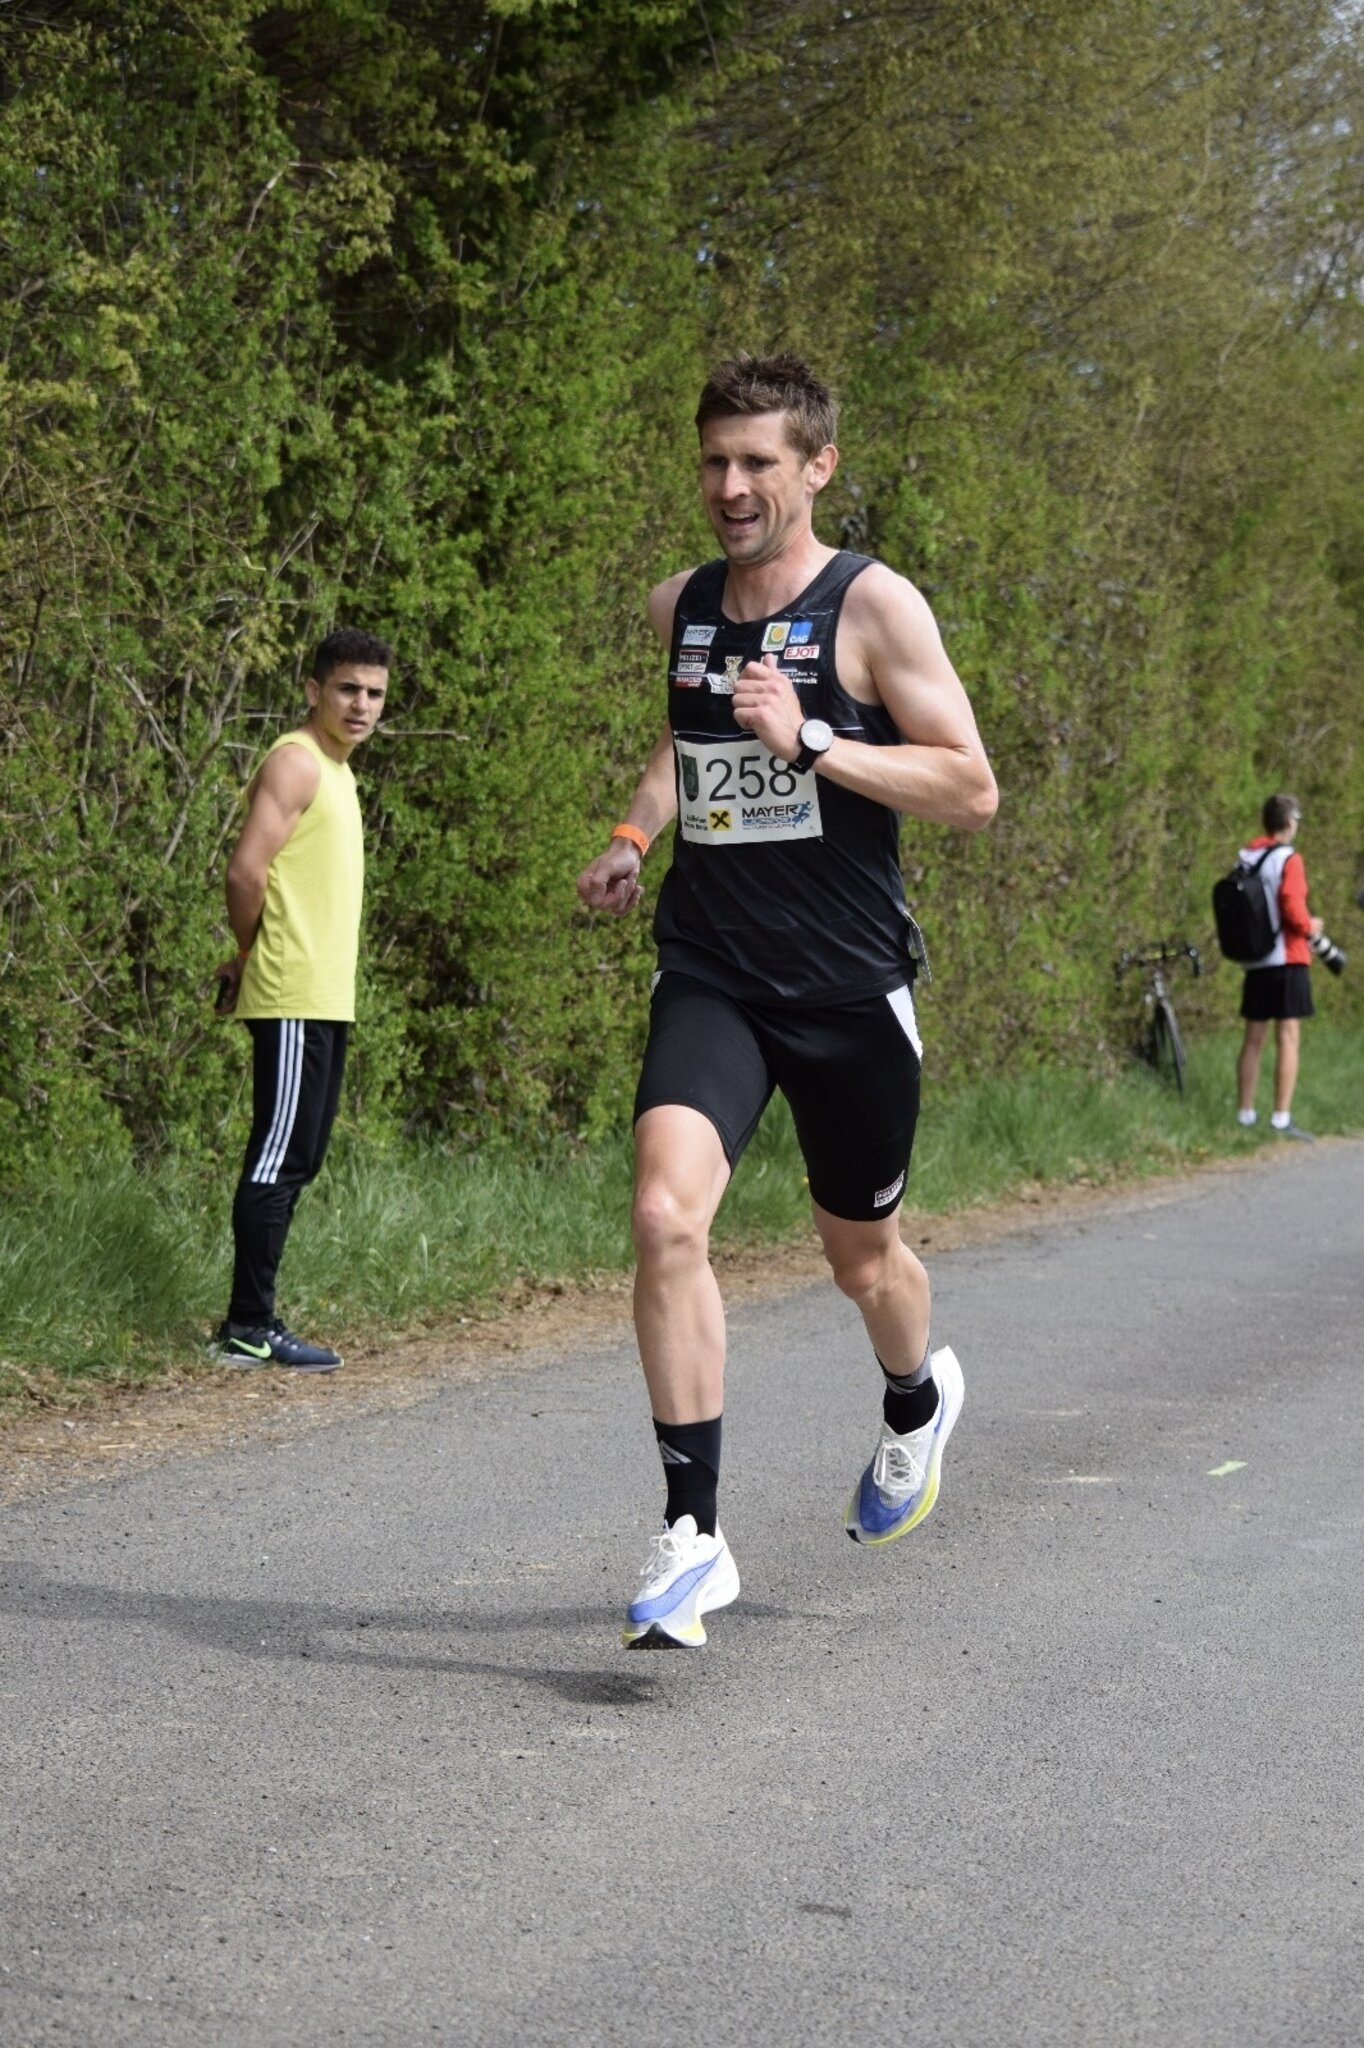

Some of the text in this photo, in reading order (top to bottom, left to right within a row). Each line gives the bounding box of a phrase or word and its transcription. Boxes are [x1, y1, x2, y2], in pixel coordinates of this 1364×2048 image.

[786, 647, 818, 658] EJOT
[705, 755, 797, 802] 258
[741, 804, 799, 819] MAYER
